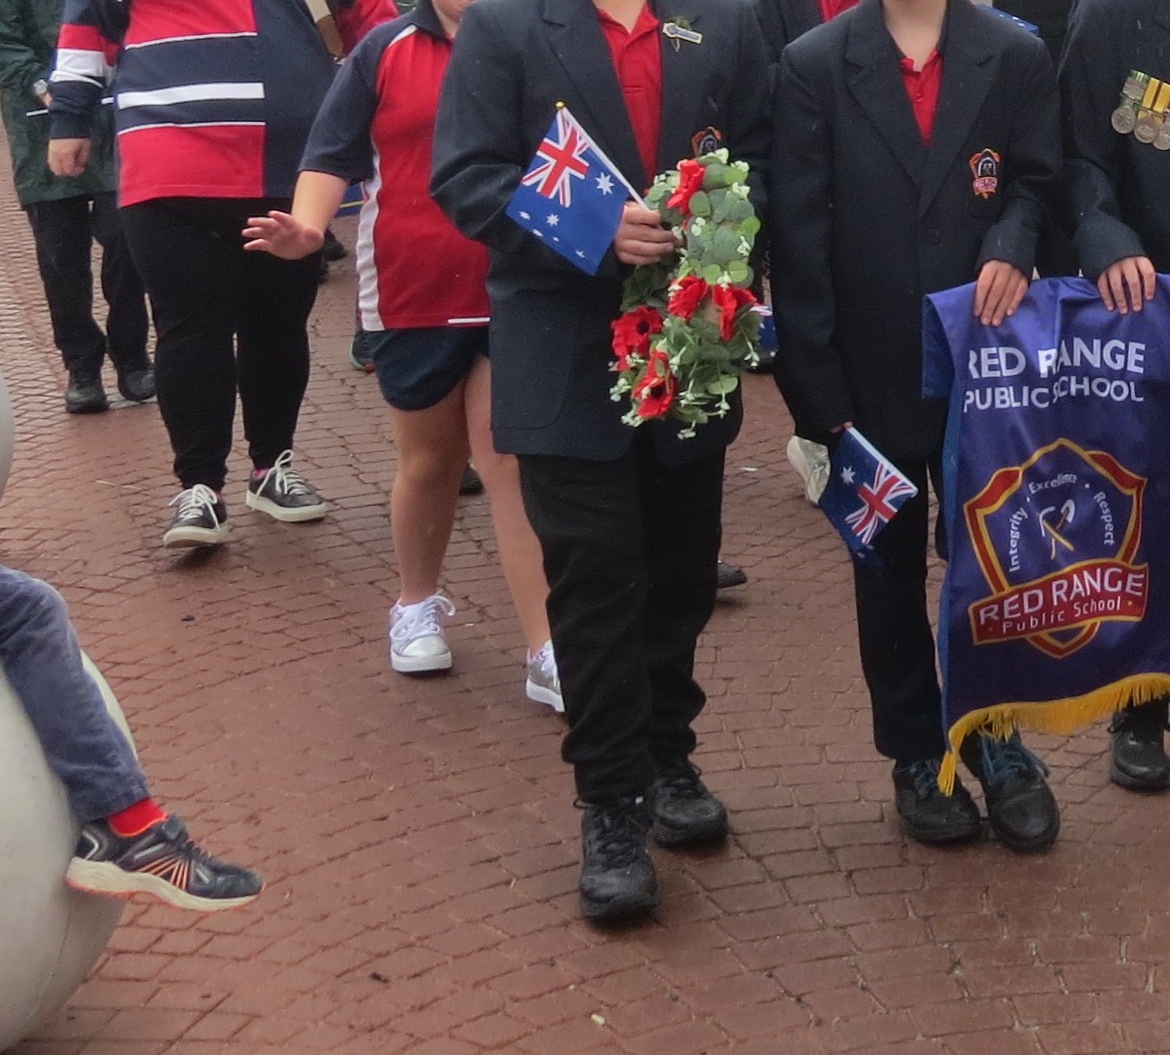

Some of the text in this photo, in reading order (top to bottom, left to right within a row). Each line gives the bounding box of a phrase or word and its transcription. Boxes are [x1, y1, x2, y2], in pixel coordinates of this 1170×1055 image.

[968, 337, 1146, 379] RED RANGE
[963, 376, 1144, 413] PUBLIC SCHOOL
[1008, 507, 1029, 573] Integrity
[1093, 491, 1115, 546] Respect
[979, 567, 1145, 626] RED RANGE
[1002, 596, 1122, 634] Public School
